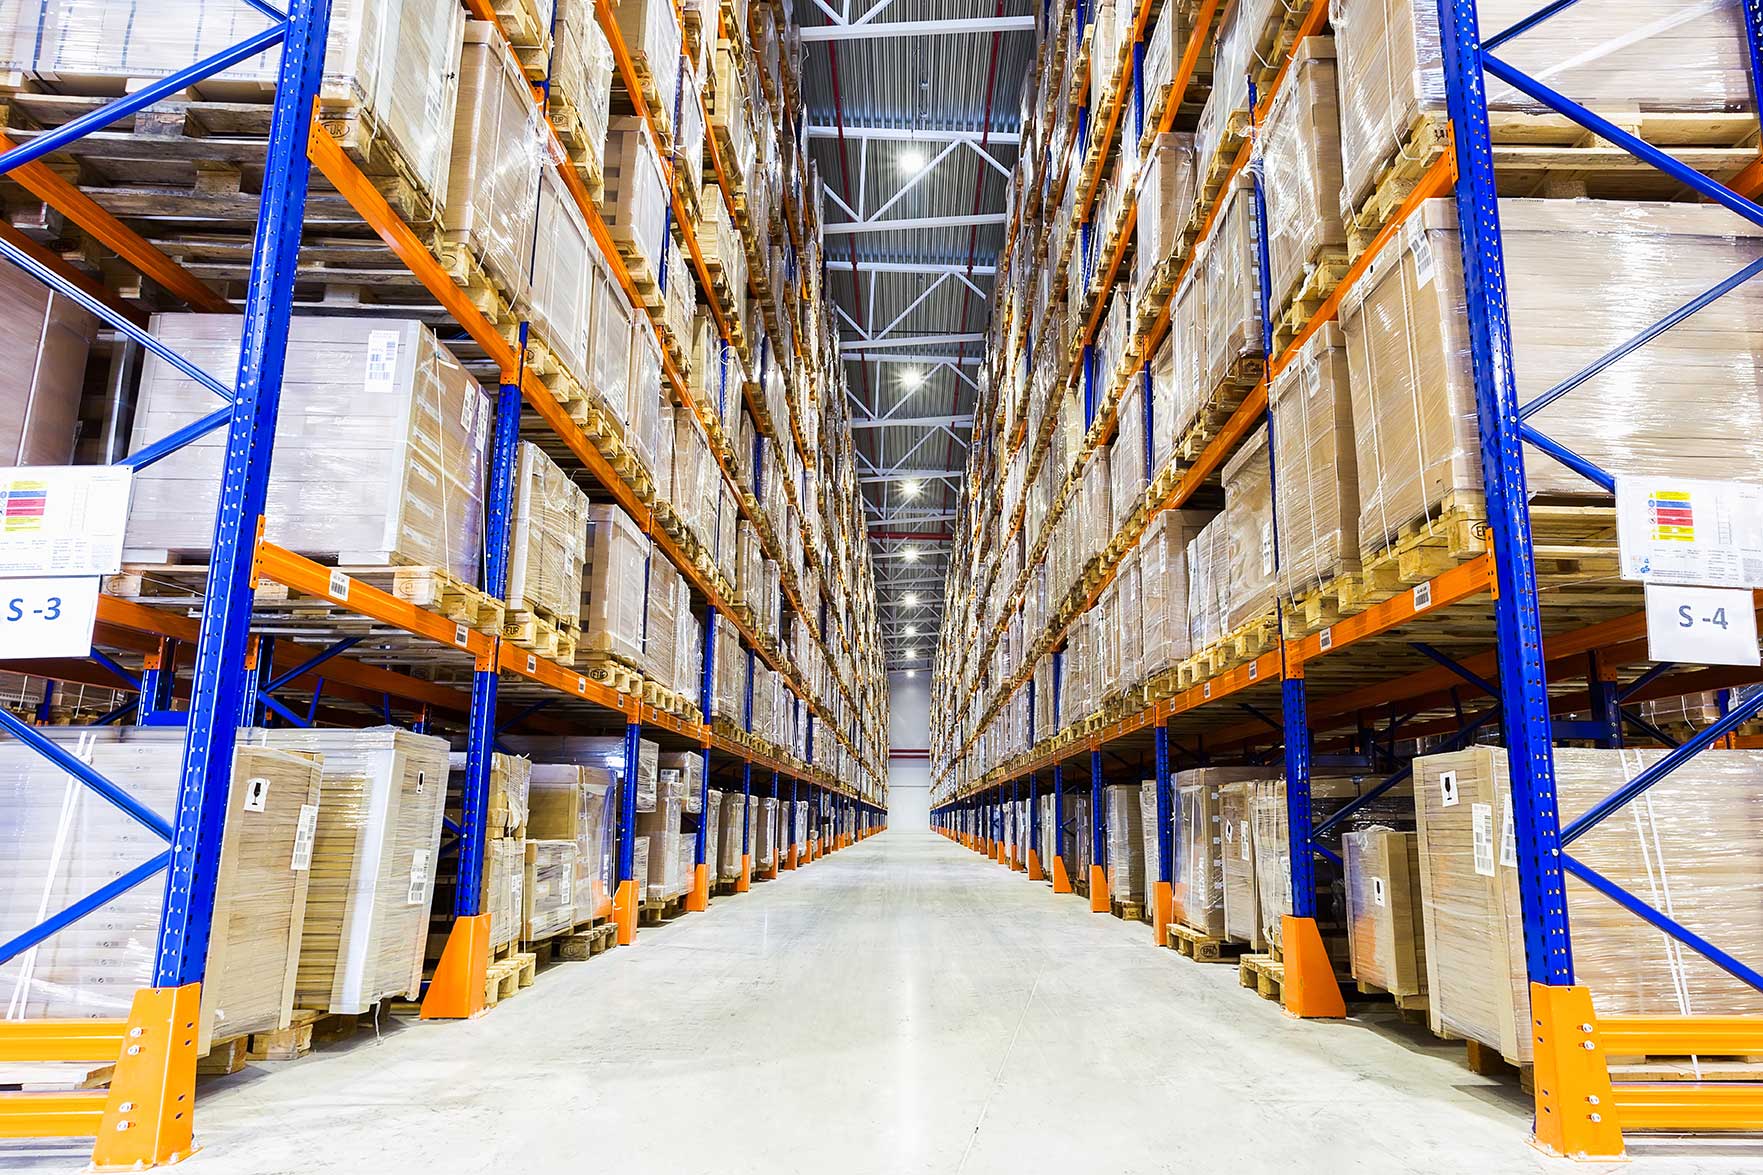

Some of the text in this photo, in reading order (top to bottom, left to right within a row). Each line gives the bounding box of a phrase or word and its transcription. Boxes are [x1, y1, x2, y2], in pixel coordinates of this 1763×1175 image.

[7, 597, 61, 621] S -3
[1679, 605, 1728, 629] S -4
